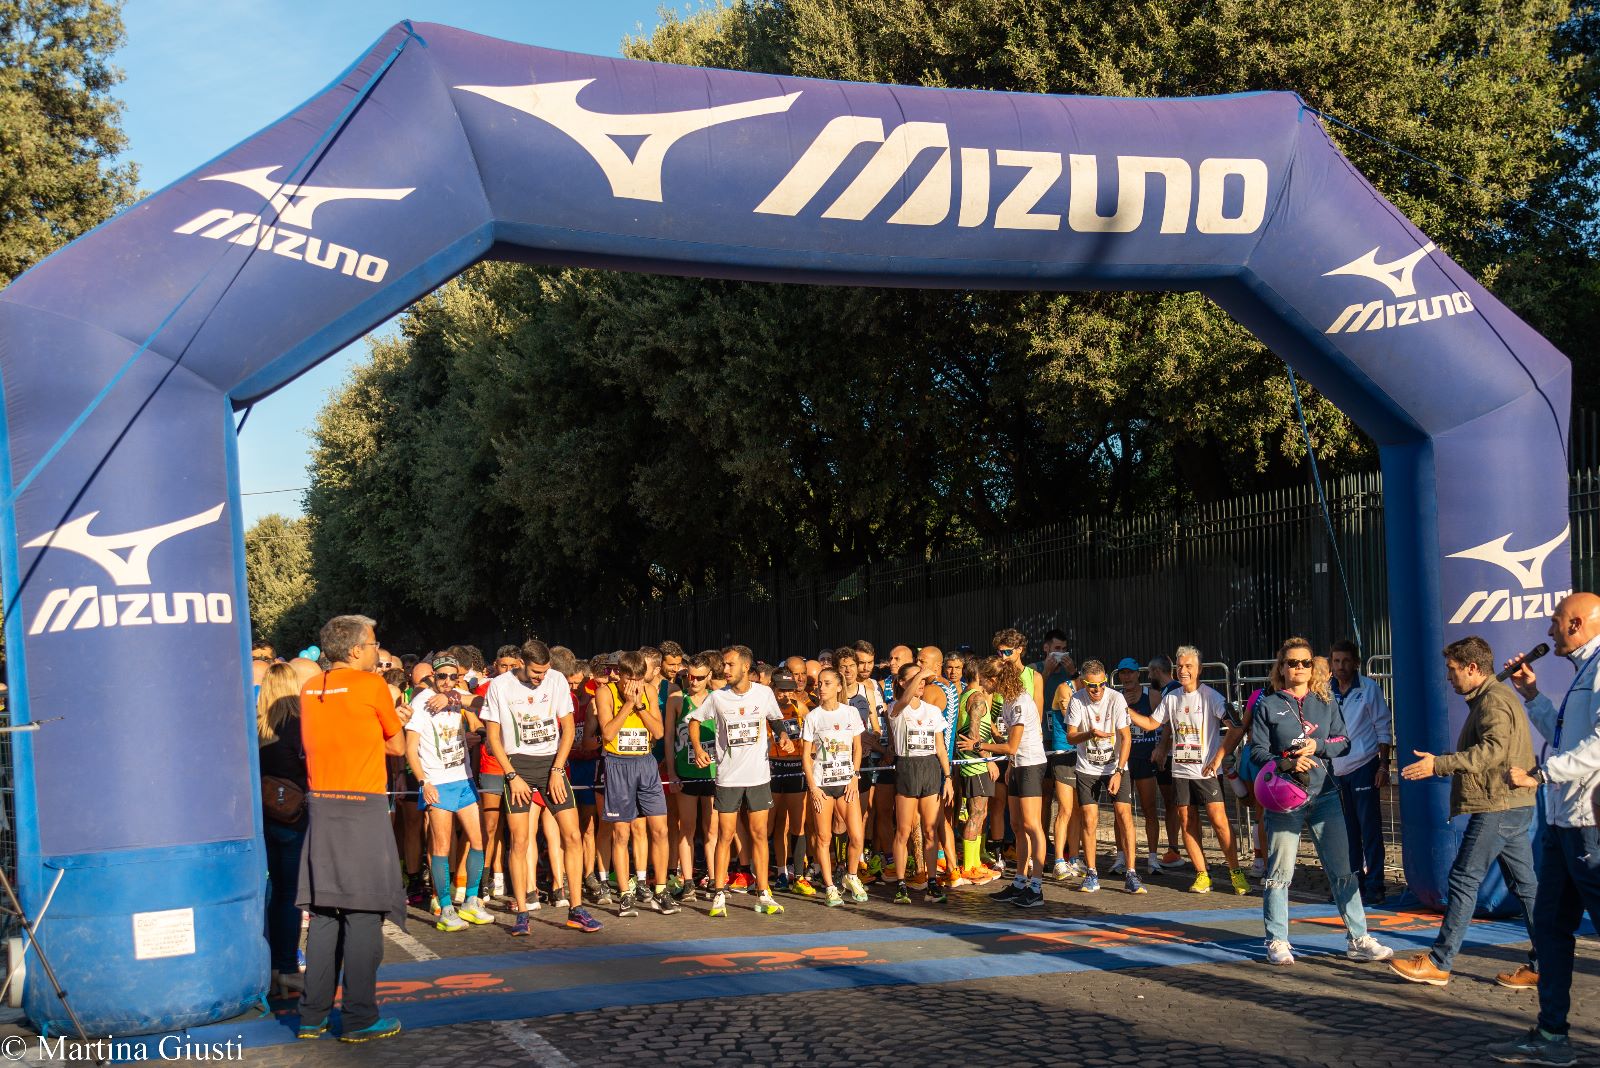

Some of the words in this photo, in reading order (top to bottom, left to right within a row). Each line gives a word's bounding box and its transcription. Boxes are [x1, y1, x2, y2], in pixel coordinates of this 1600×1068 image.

[753, 115, 1268, 234] MIZUNO
[173, 208, 389, 283] MIZUNO
[1324, 291, 1475, 334] MIZUNO
[29, 585, 233, 635] MIZUNO
[1448, 589, 1573, 623] MIZU
